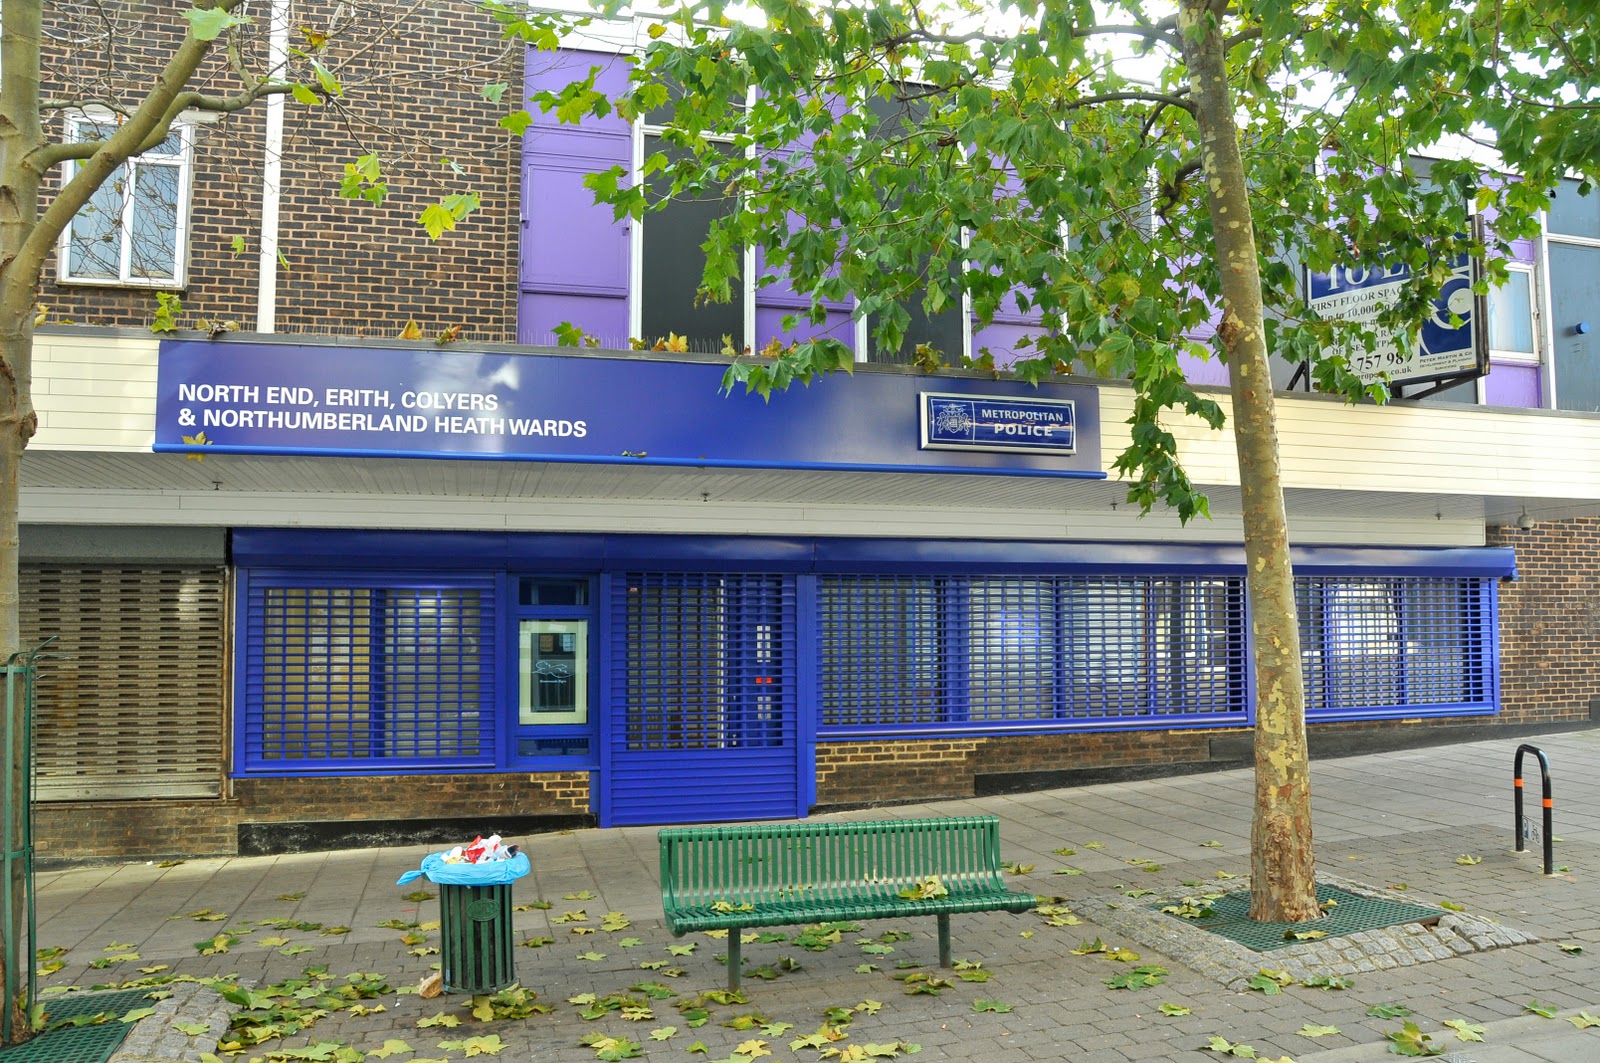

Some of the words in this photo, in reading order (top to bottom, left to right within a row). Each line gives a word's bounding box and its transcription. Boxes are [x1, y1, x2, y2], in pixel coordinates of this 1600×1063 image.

[1340, 292, 1375, 306] FLOOR
[1377, 286, 1402, 299] SPAC
[1351, 344, 1365, 352] SES
[1356, 354, 1381, 371] 757
[1386, 352, 1413, 367] 98
[178, 383, 259, 403] NORTH
[266, 386, 319, 408] END,
[325, 388, 396, 410] ERITH,
[401, 391, 499, 411] COLYERS
[178, 408, 196, 426] &
[203, 409, 428, 433] NORTHUMBERLAND
[434, 415, 504, 435] HEATH
[508, 418, 587, 438] WARDS
[981, 408, 1064, 422] METROPOLITAN
[994, 423, 1054, 437] POLICE
